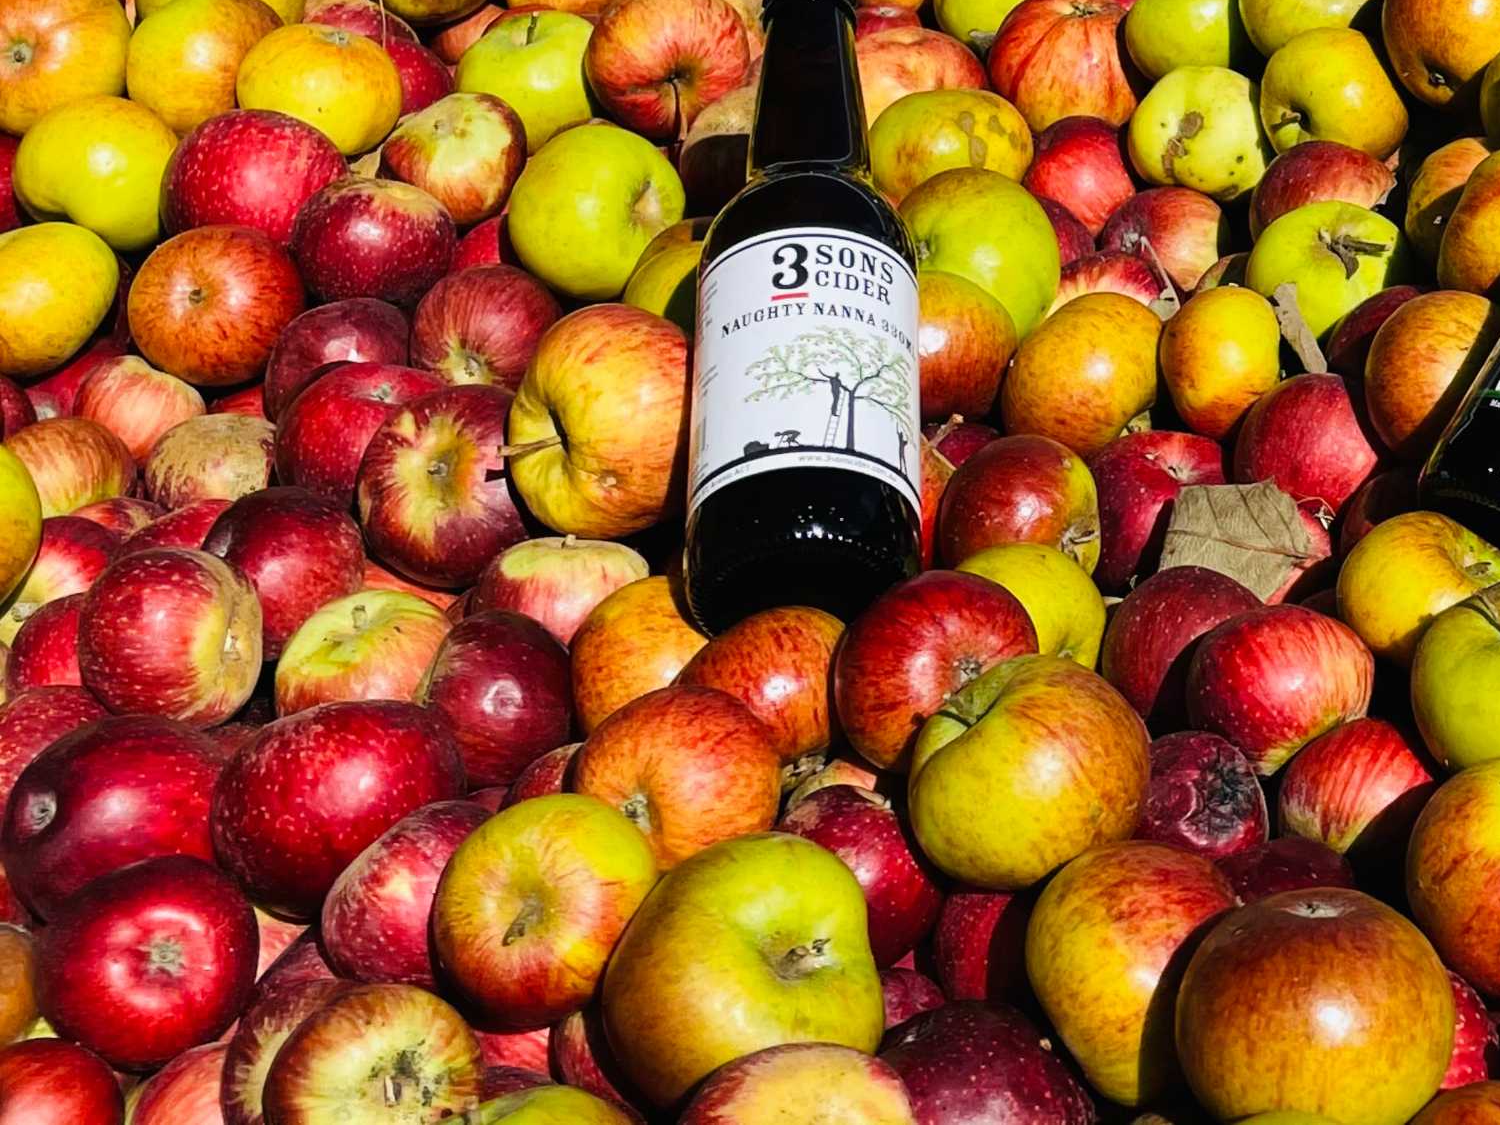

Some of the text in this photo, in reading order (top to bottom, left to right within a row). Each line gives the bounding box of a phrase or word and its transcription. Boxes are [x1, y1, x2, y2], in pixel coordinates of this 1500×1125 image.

[772, 243, 894, 290] 3 SONS
[815, 270, 891, 306] CIDER
[720, 302, 806, 339] NAUGHTY
[814, 302, 878, 326] NANNA
